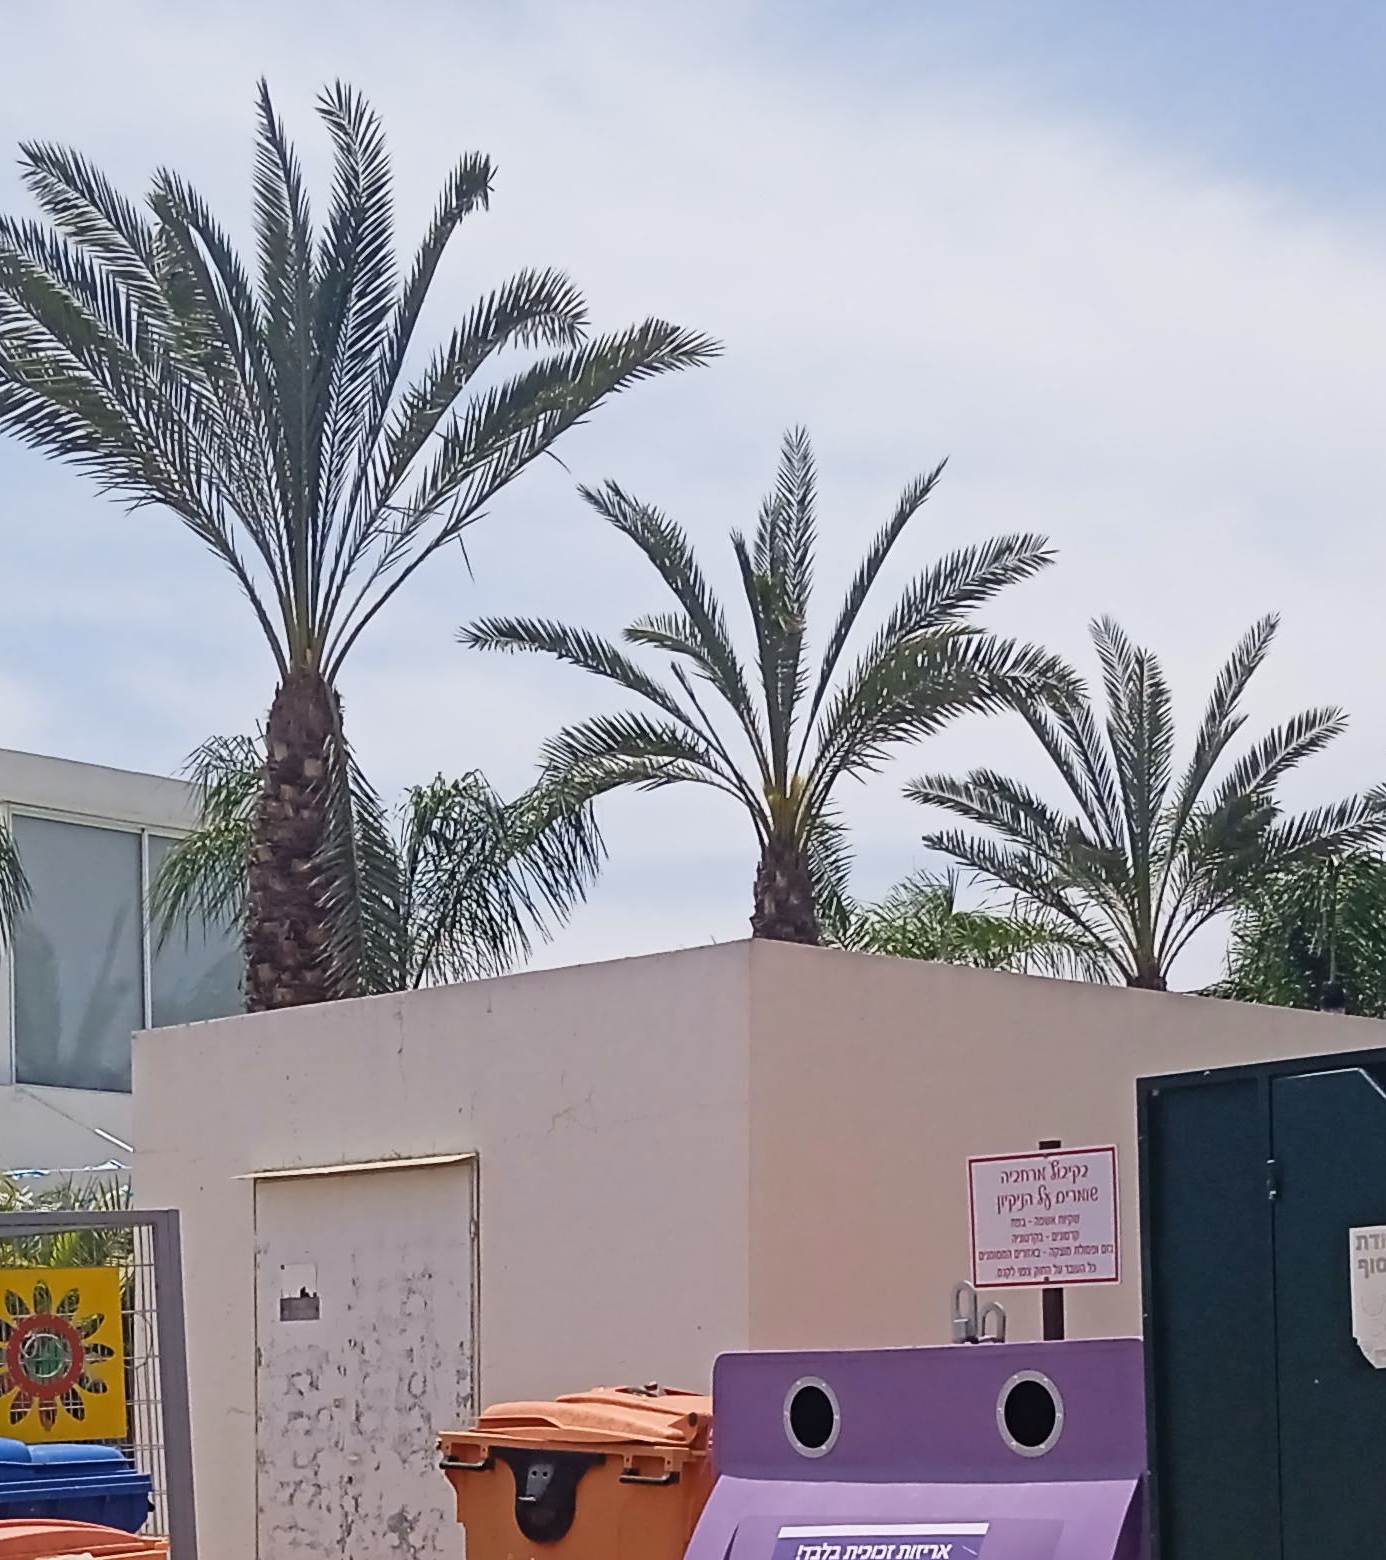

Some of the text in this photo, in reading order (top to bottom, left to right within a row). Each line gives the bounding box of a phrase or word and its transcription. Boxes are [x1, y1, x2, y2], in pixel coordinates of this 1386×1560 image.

[997, 1184, 1098, 1215] שומרים על הניקיון
[842, 1544, 897, 1560] זכוכית
[896, 1543, 953, 1560] אריזות
